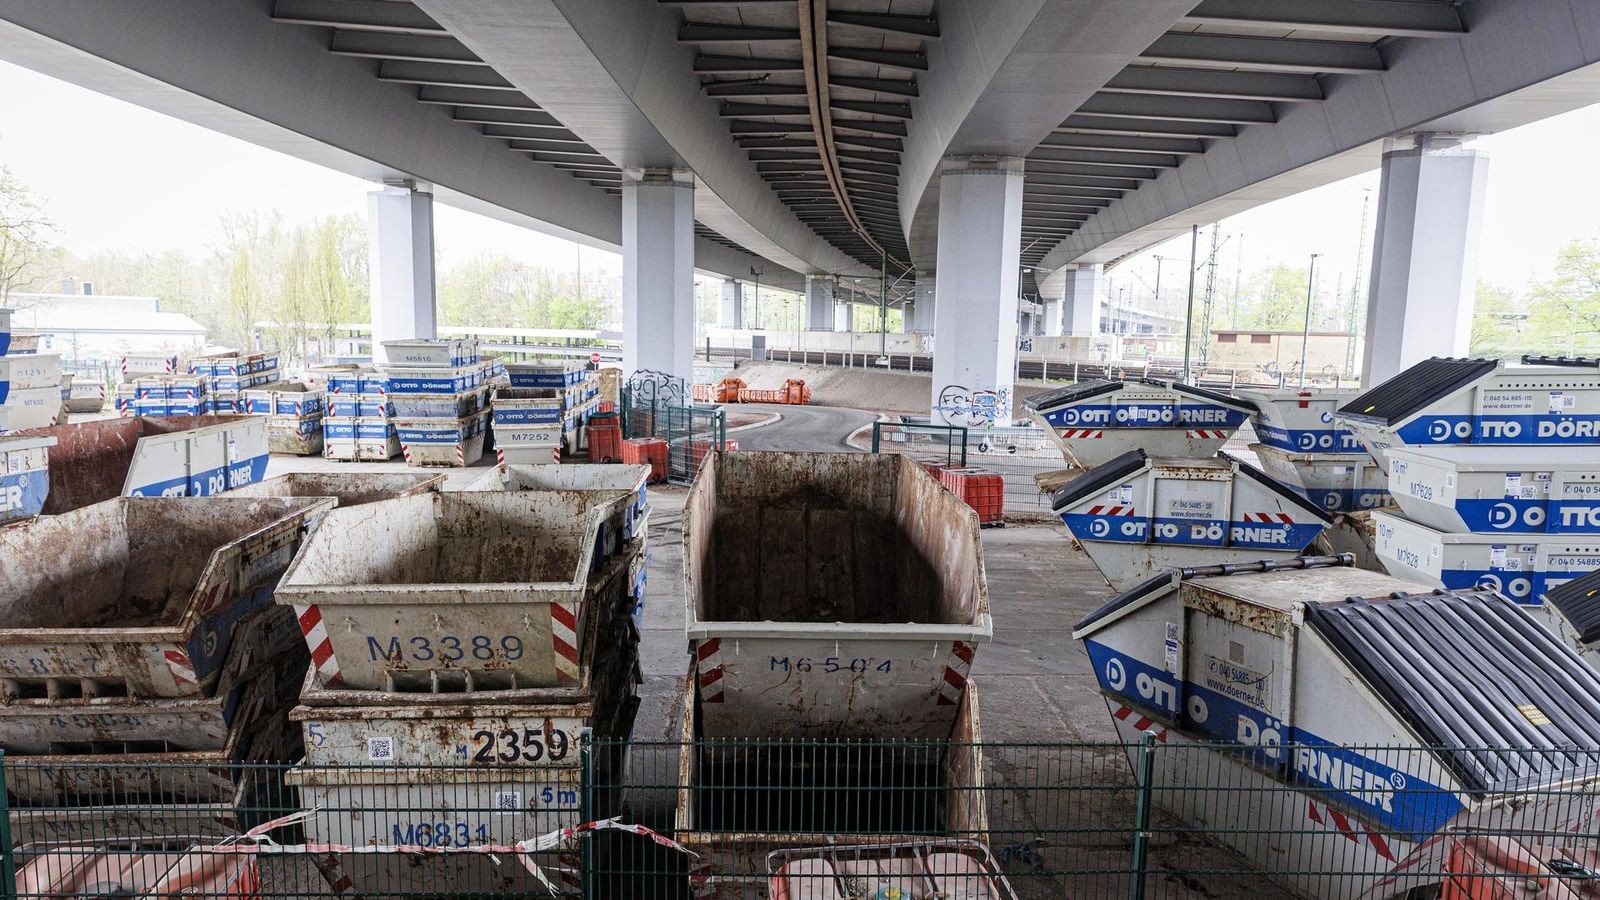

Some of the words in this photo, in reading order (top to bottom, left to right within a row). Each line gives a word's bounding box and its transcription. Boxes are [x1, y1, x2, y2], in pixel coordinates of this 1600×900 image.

[422, 381, 452, 389] DÖRNER
[1081, 409, 1130, 423] OTTO
[1147, 405, 1227, 423] DÖRNER
[512, 433, 550, 441] M7252
[1454, 421, 1522, 438] OTTO
[1360, 494, 1392, 507] OTT
[1410, 482, 1433, 501] M7629
[1170, 511, 1213, 519] www.doerner.de
[1121, 522, 1179, 539] OTTO
[1191, 522, 1287, 544] DÖRNER
[1396, 547, 1419, 568] M7628
[1558, 558, 1574, 566] 040
[366, 635, 525, 662] M3389
[770, 656, 892, 674] M6504
[1219, 663, 1230, 680] 040
[1206, 677, 1265, 709] www.doerner.de
[473, 728, 569, 763] 2359
[1136, 672, 1208, 724] OTTO
[1237, 714, 1394, 814] DÖRNER
[393, 823, 486, 848] M6831
